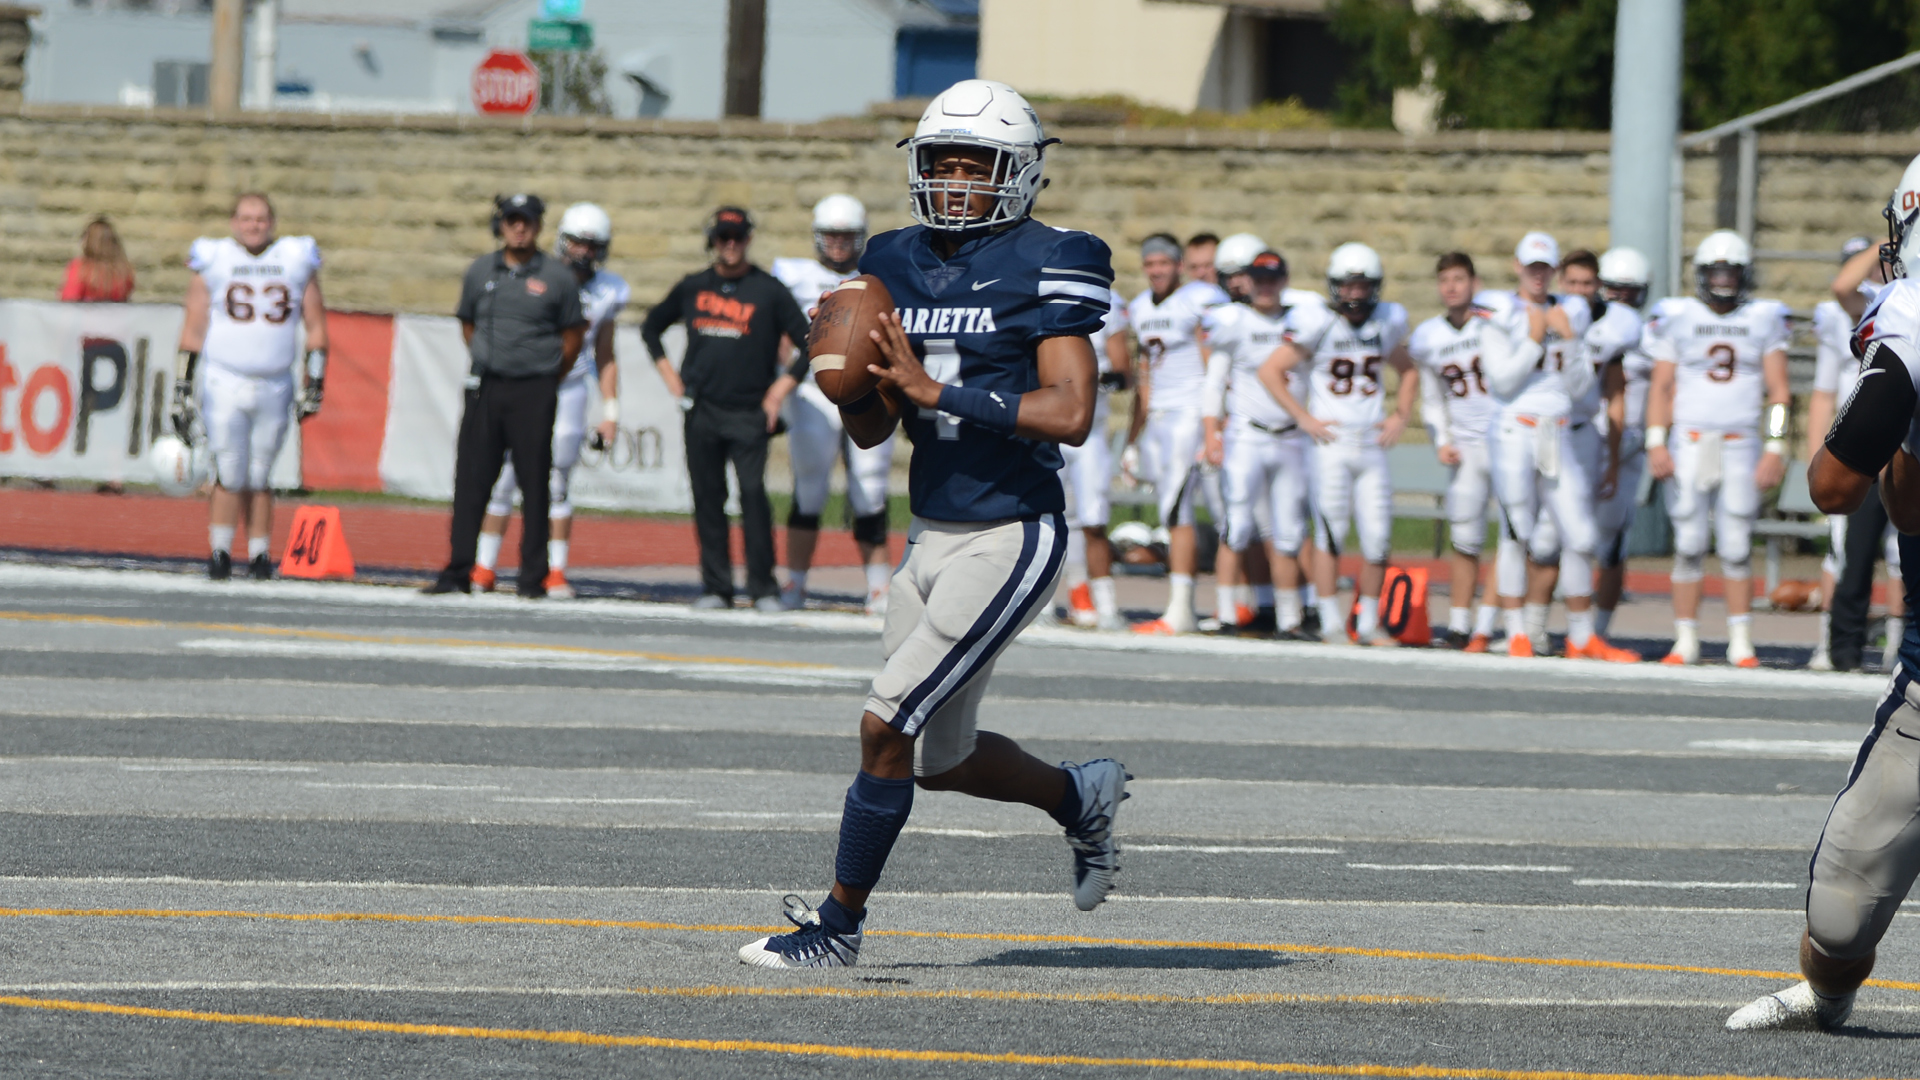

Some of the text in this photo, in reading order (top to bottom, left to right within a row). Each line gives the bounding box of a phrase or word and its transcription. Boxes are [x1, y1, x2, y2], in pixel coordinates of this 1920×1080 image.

[476, 67, 534, 107] STOP
[1902, 190, 1920, 211] O
[225, 282, 293, 323] 63
[895, 307, 997, 333] ARIETTA
[1706, 342, 1736, 383] 3
[290, 517, 327, 567] 40
